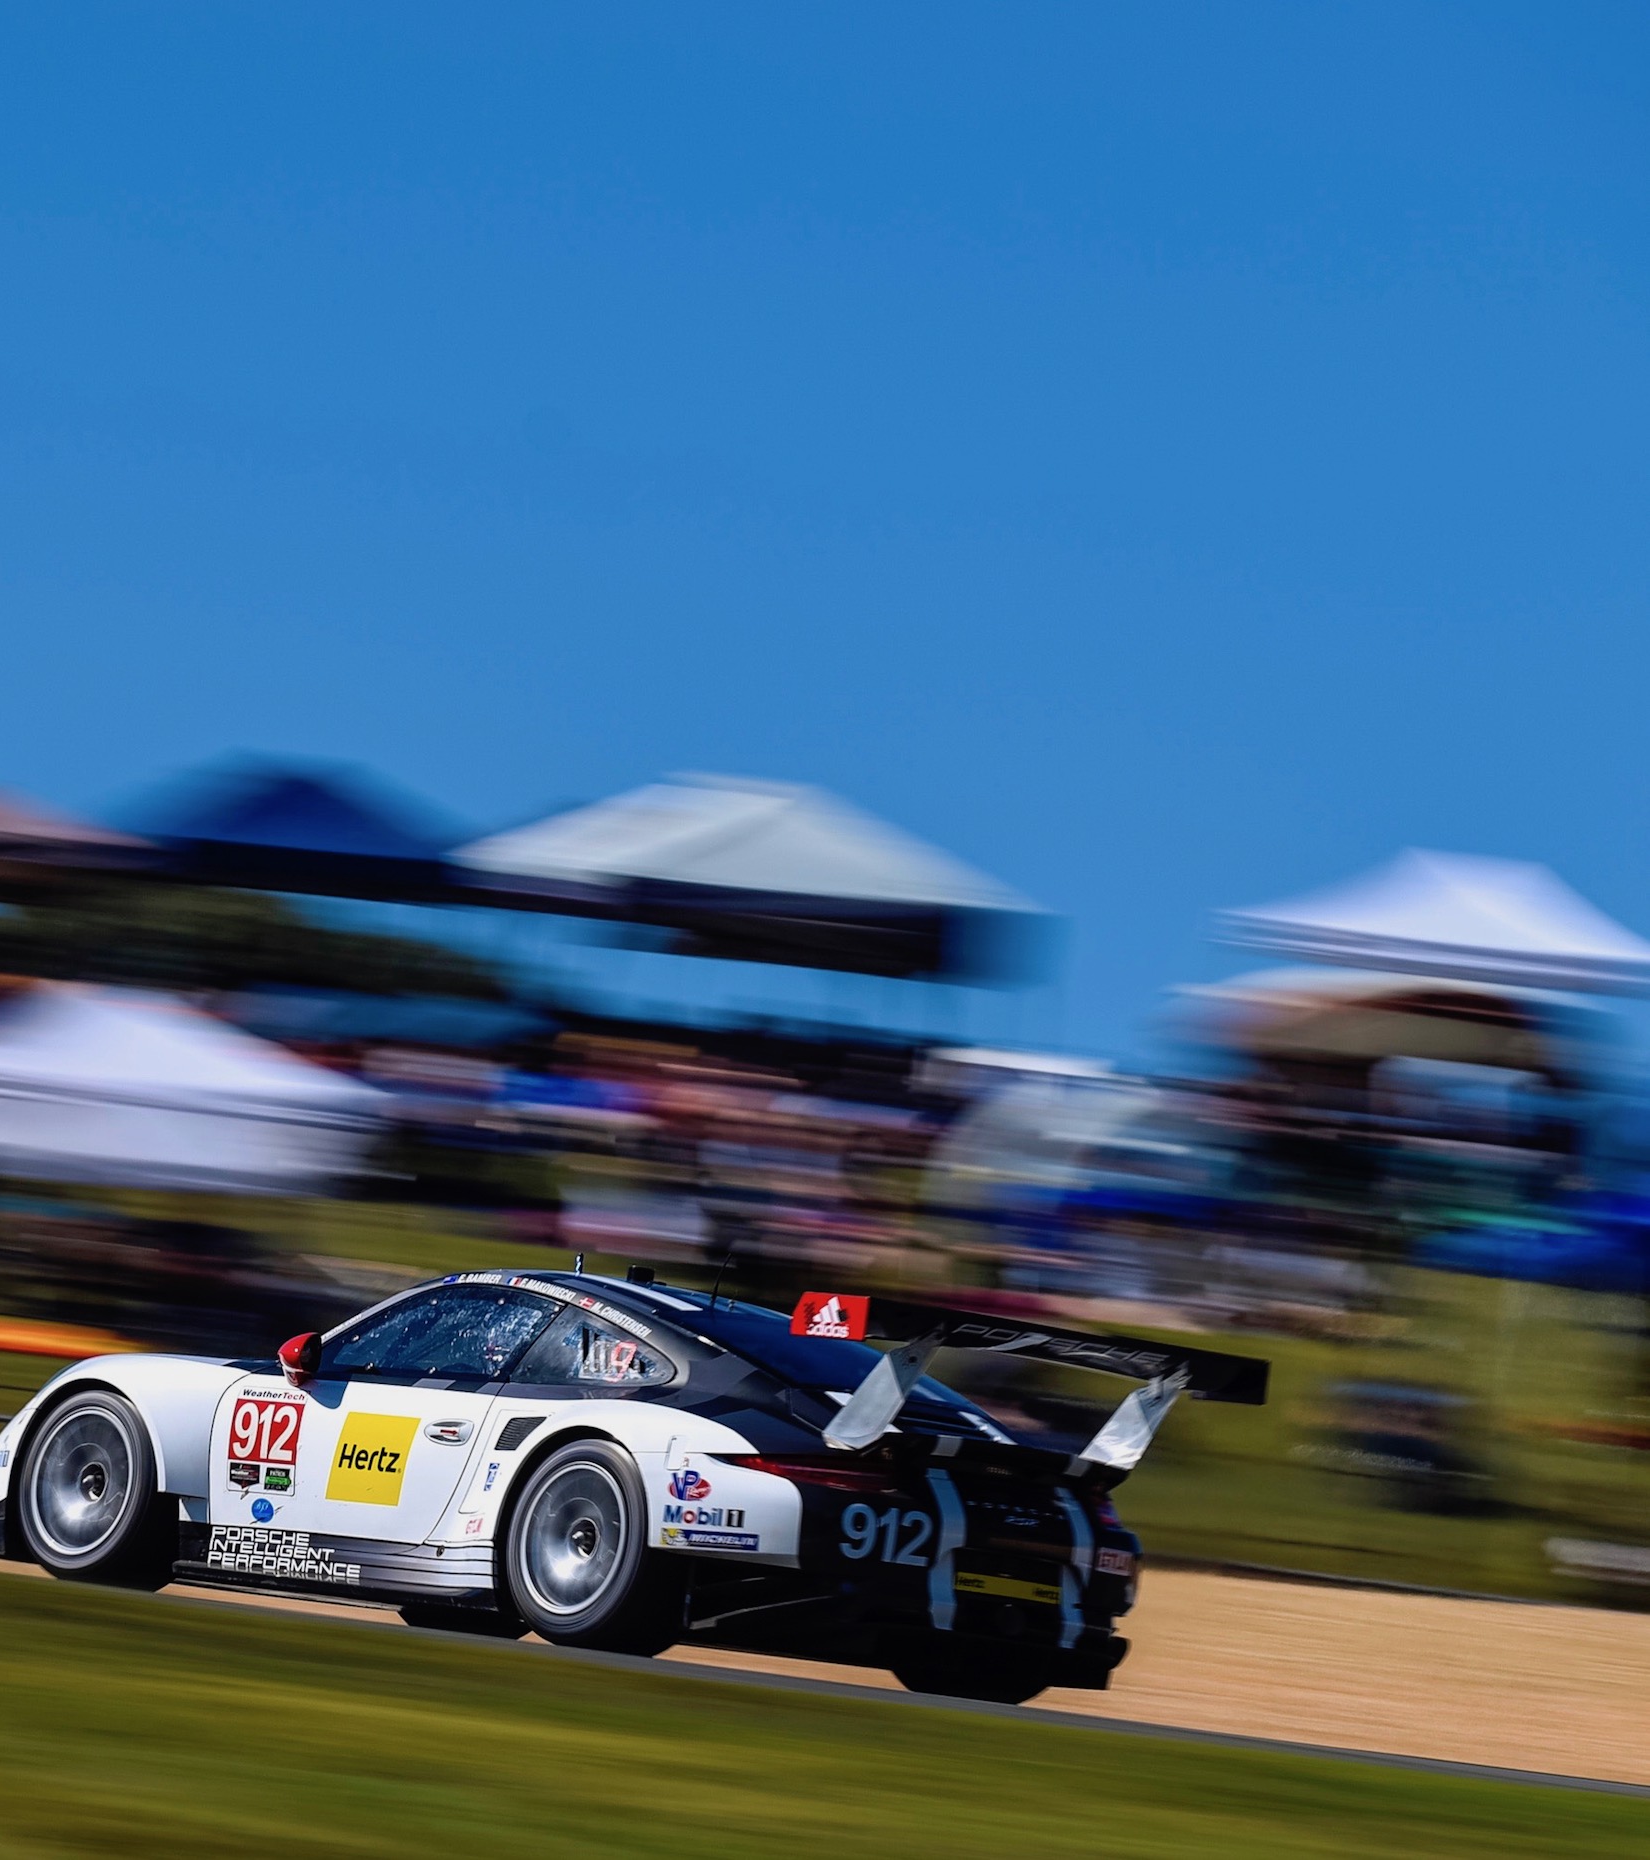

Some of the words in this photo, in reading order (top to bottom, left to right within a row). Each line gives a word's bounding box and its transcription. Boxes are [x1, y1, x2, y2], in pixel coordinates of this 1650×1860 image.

[806, 1321, 849, 1338] adidas
[952, 1324, 1171, 1363] POSCHE
[243, 1388, 306, 1401] WeatherTech
[232, 1402, 298, 1461] 912
[338, 1443, 400, 1473] Hertz
[663, 1504, 723, 1527] Mobil
[728, 1508, 742, 1528] 1
[211, 1526, 311, 1547] PORSCHE
[689, 1533, 757, 1547] MICHELIN
[839, 1503, 932, 1567] 912
[209, 1538, 335, 1562] INTELLIGENT
[207, 1551, 361, 1579] PERFORMANCE
